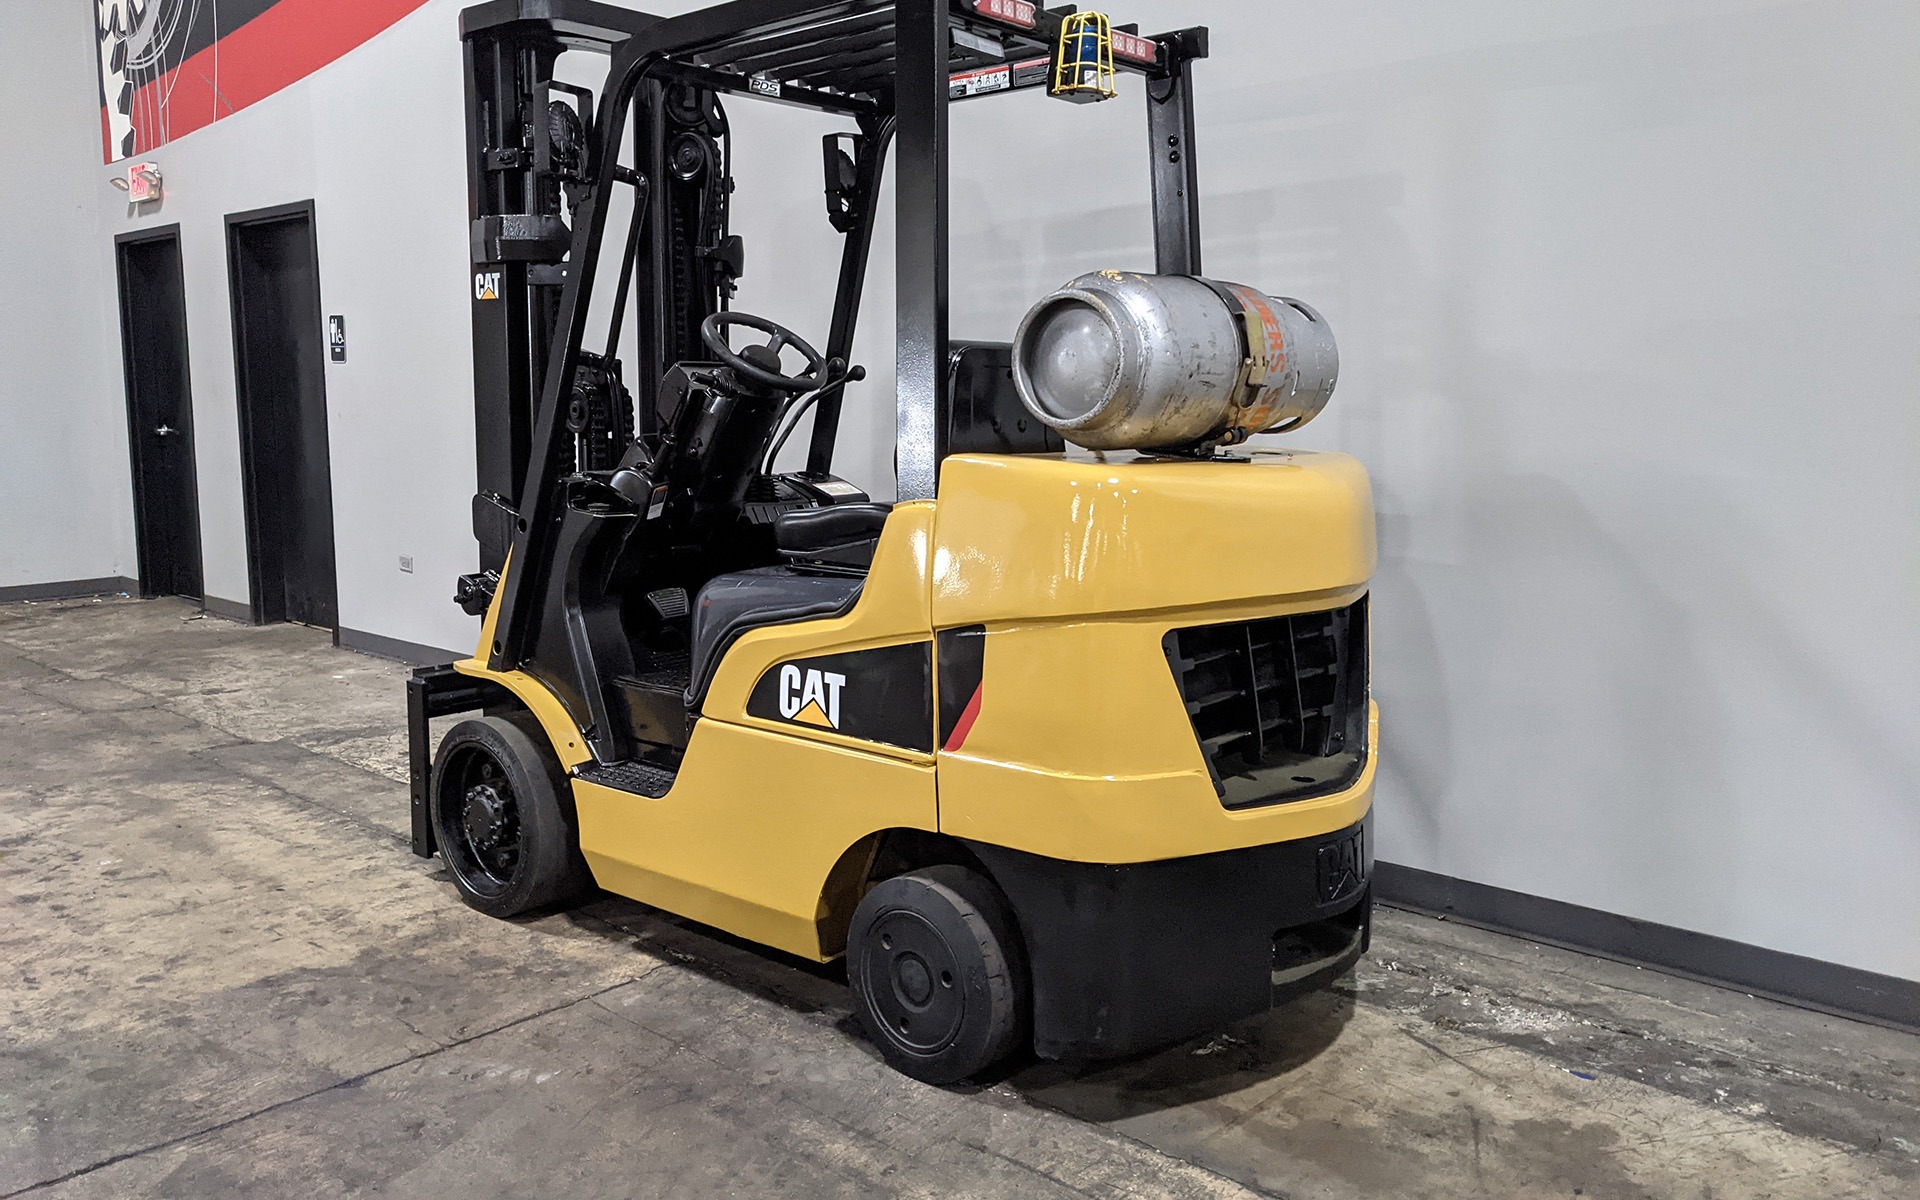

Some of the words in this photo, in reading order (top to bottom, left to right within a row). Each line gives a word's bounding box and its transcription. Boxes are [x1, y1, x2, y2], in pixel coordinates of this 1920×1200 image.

[751, 80, 778, 92] PDS
[475, 272, 501, 300] CAT
[779, 664, 846, 730] CAT
